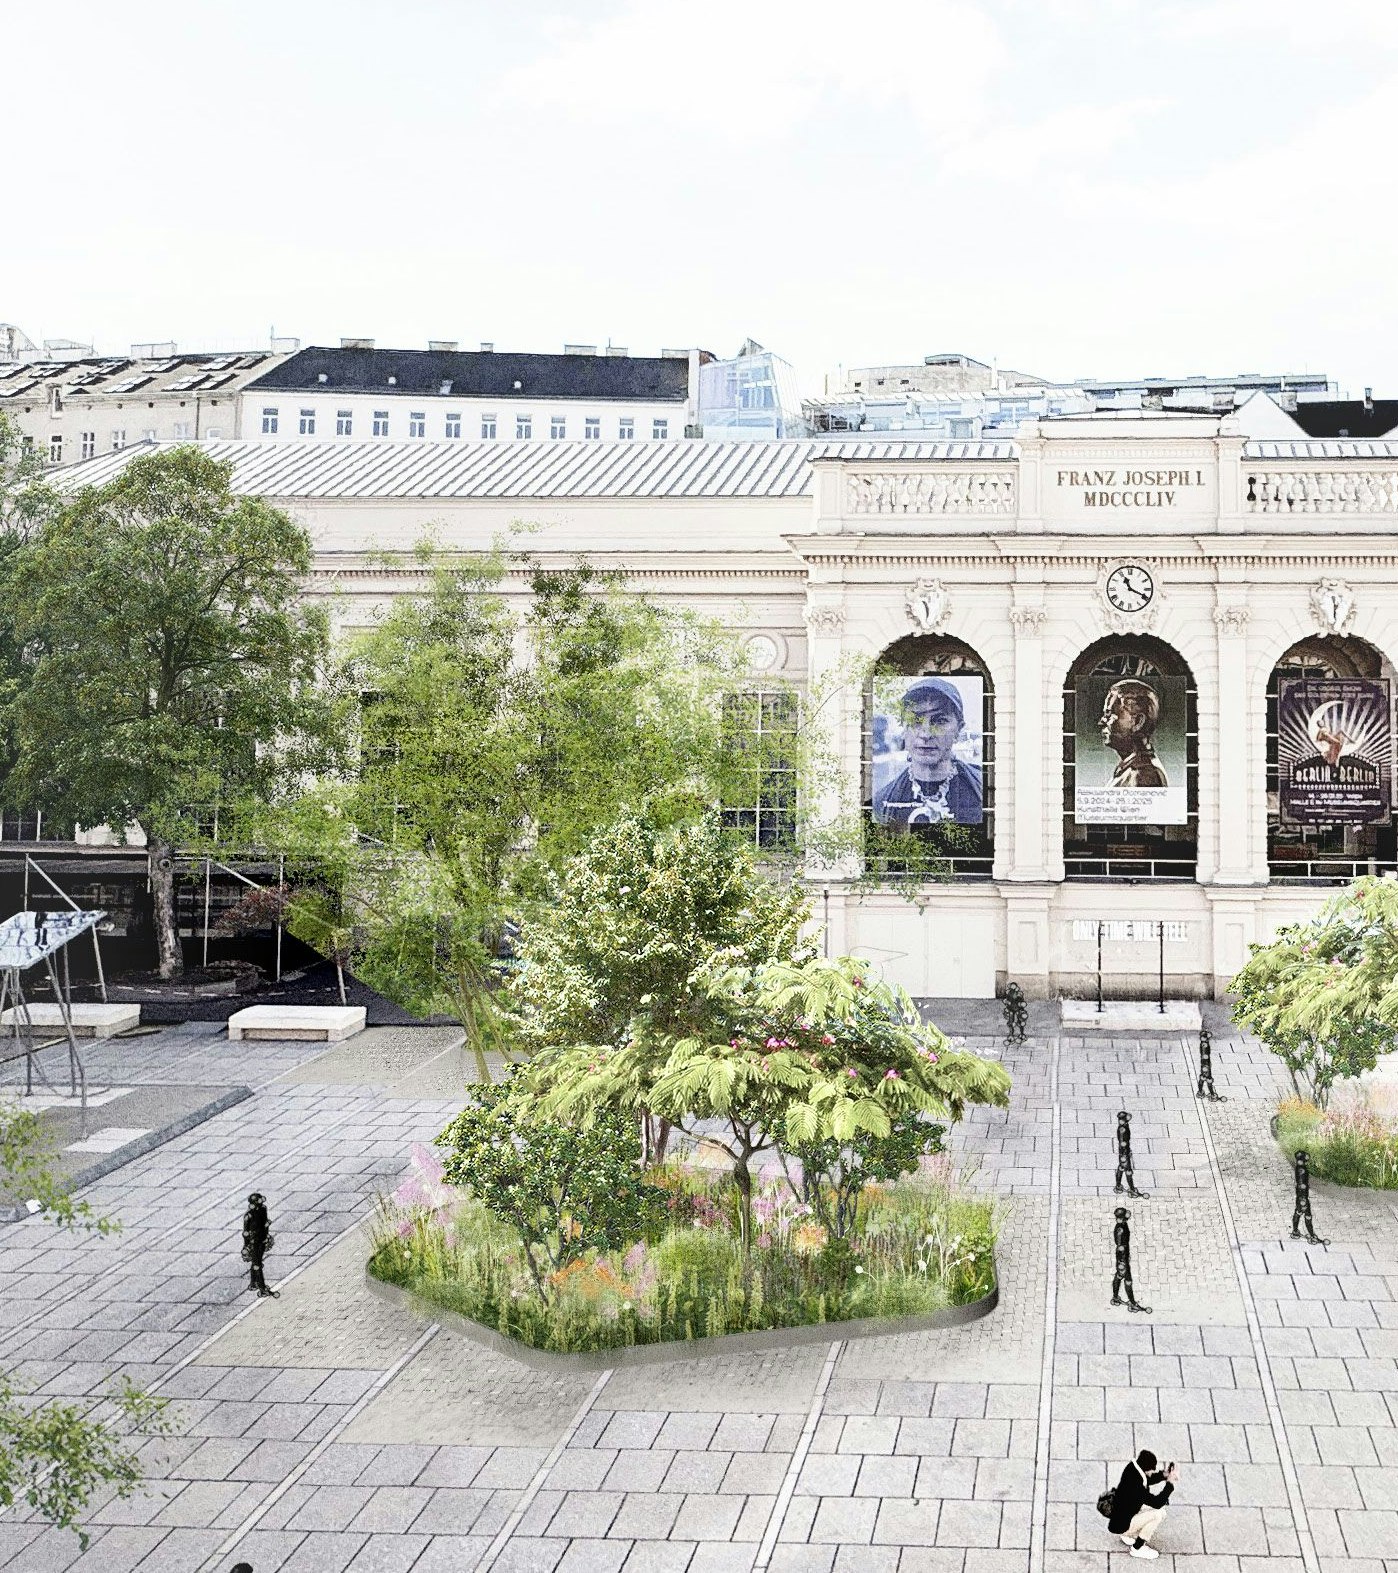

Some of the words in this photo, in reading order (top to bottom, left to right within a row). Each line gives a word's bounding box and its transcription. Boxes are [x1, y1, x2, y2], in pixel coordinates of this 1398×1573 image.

[1057, 470, 1116, 486] FRANZ
[1295, 766, 1331, 783] BERLIN
[1339, 766, 1375, 783] BERLIN
